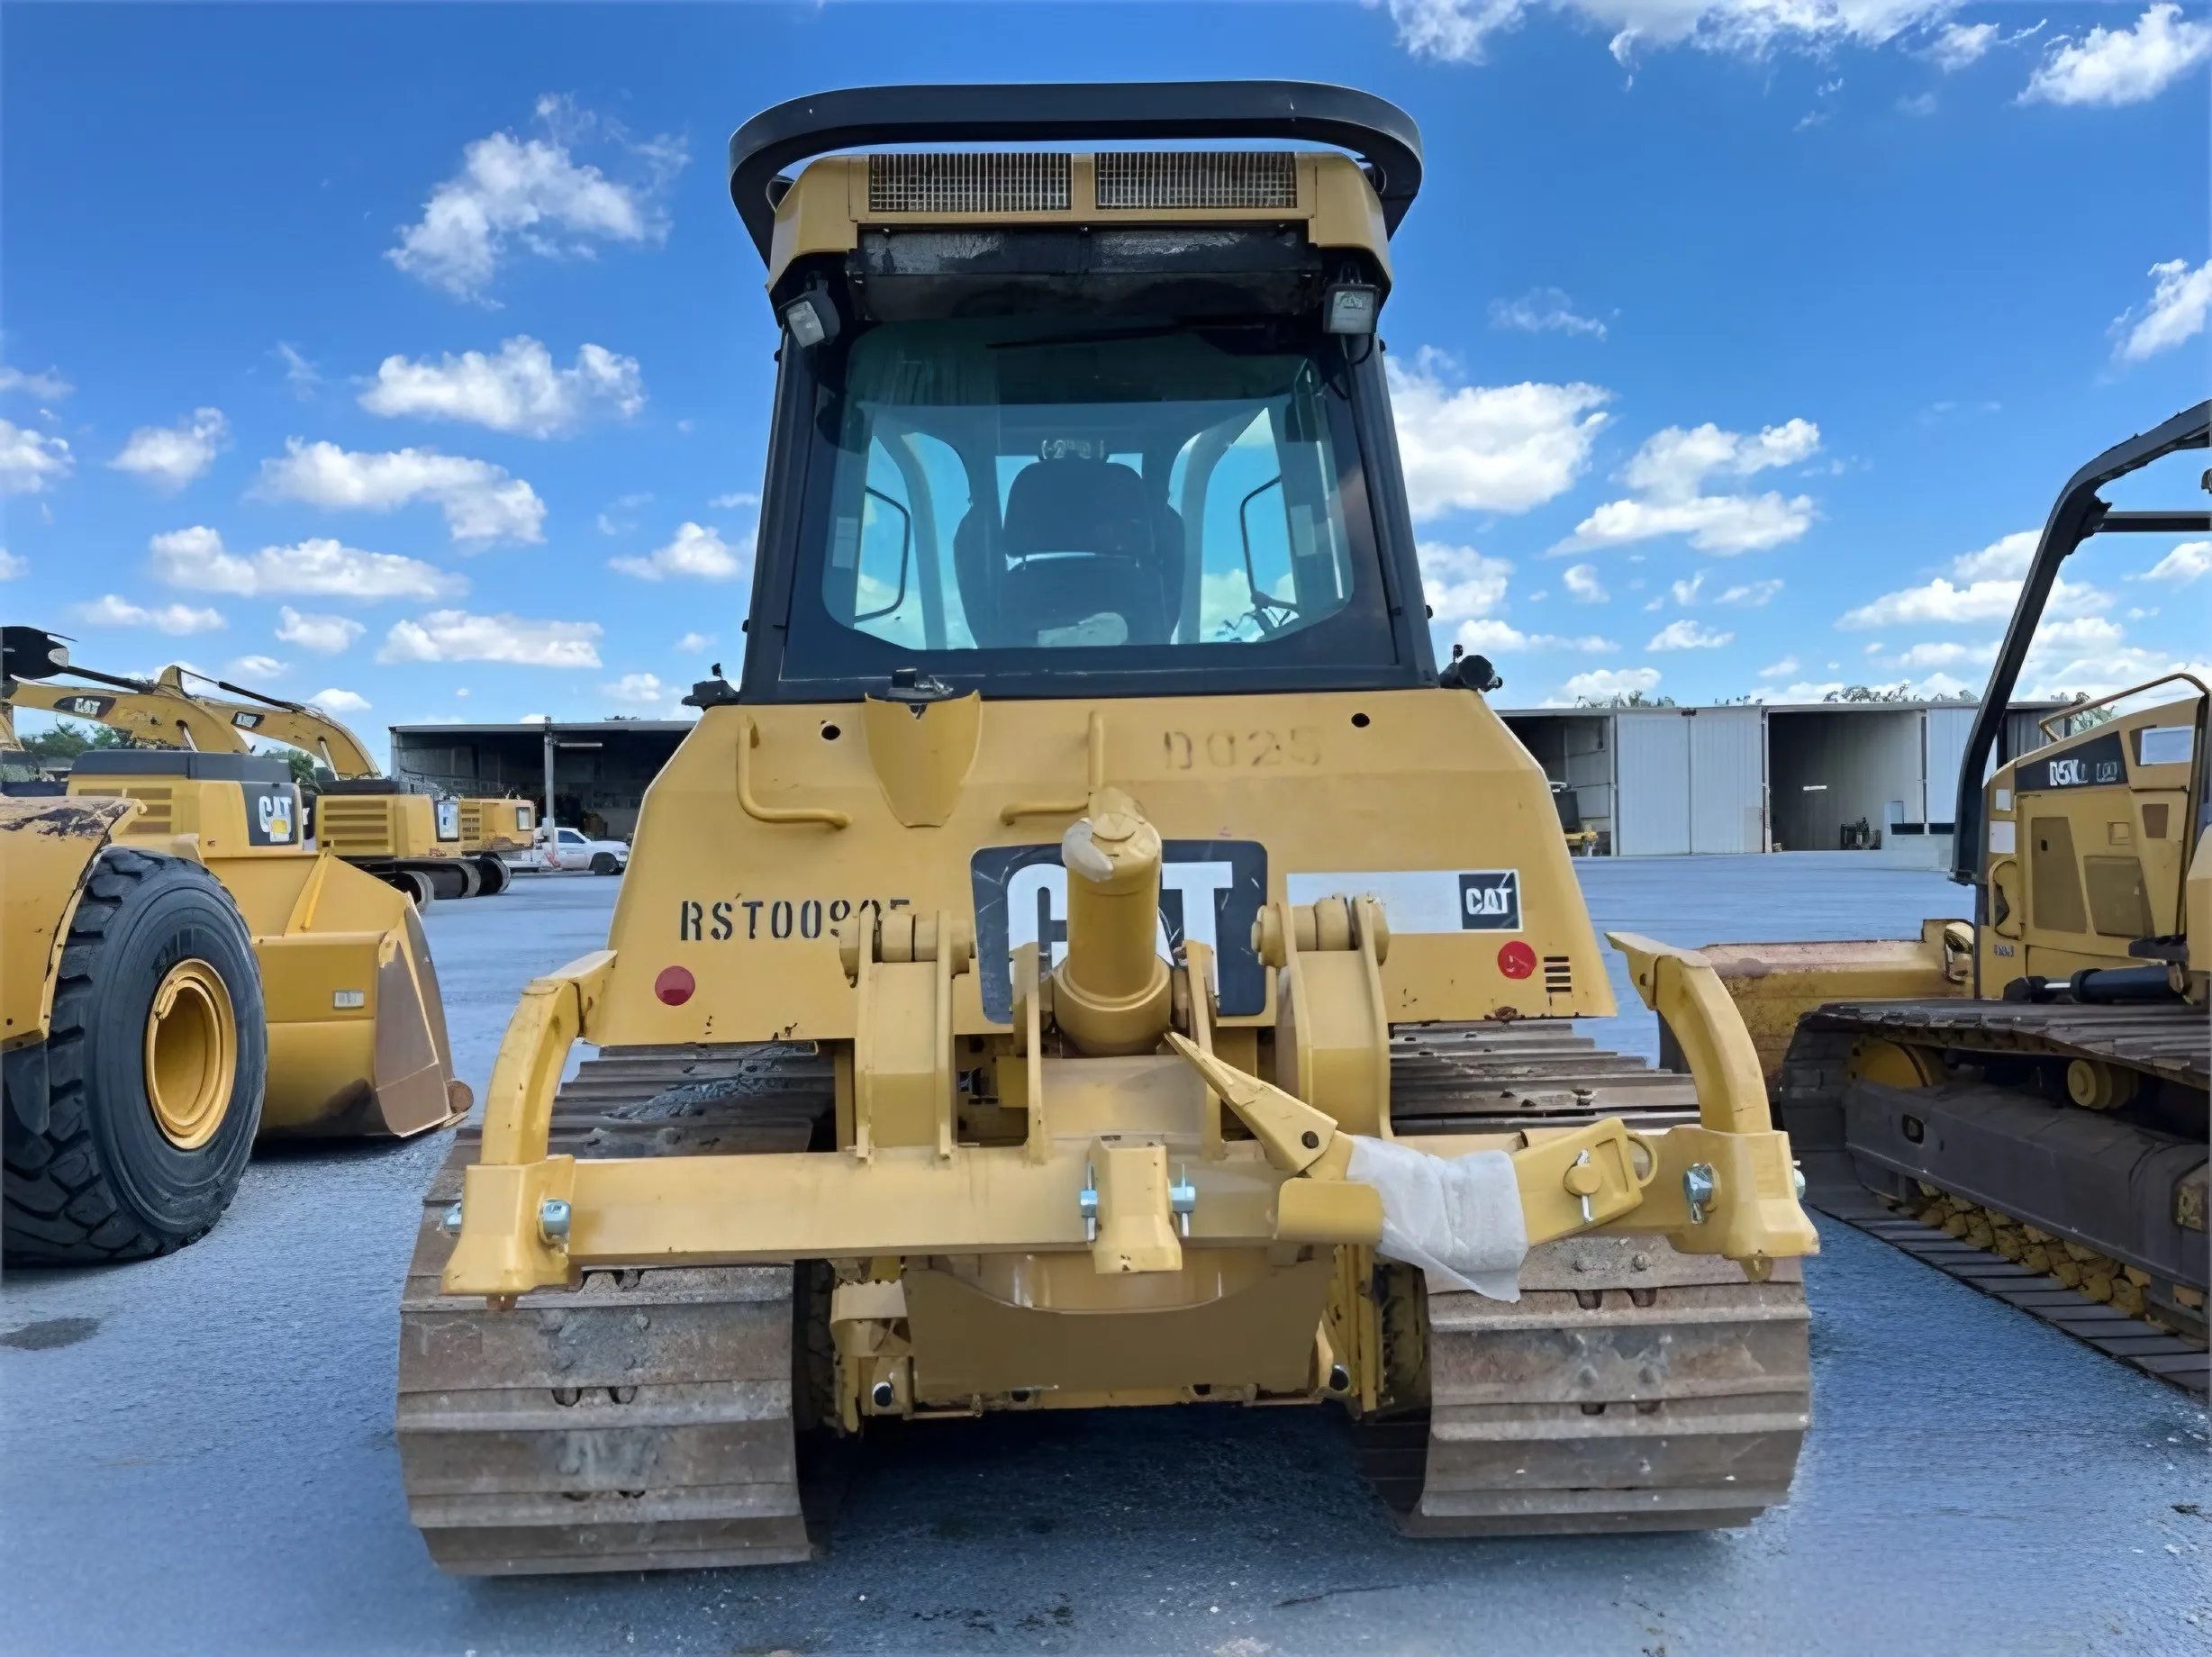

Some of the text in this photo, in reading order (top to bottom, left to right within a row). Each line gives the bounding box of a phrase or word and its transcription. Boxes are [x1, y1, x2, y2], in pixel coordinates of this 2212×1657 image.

[680, 899, 910, 941] RST009
[1465, 887, 1512, 914] CAT
[1007, 862, 1233, 1010] CT
